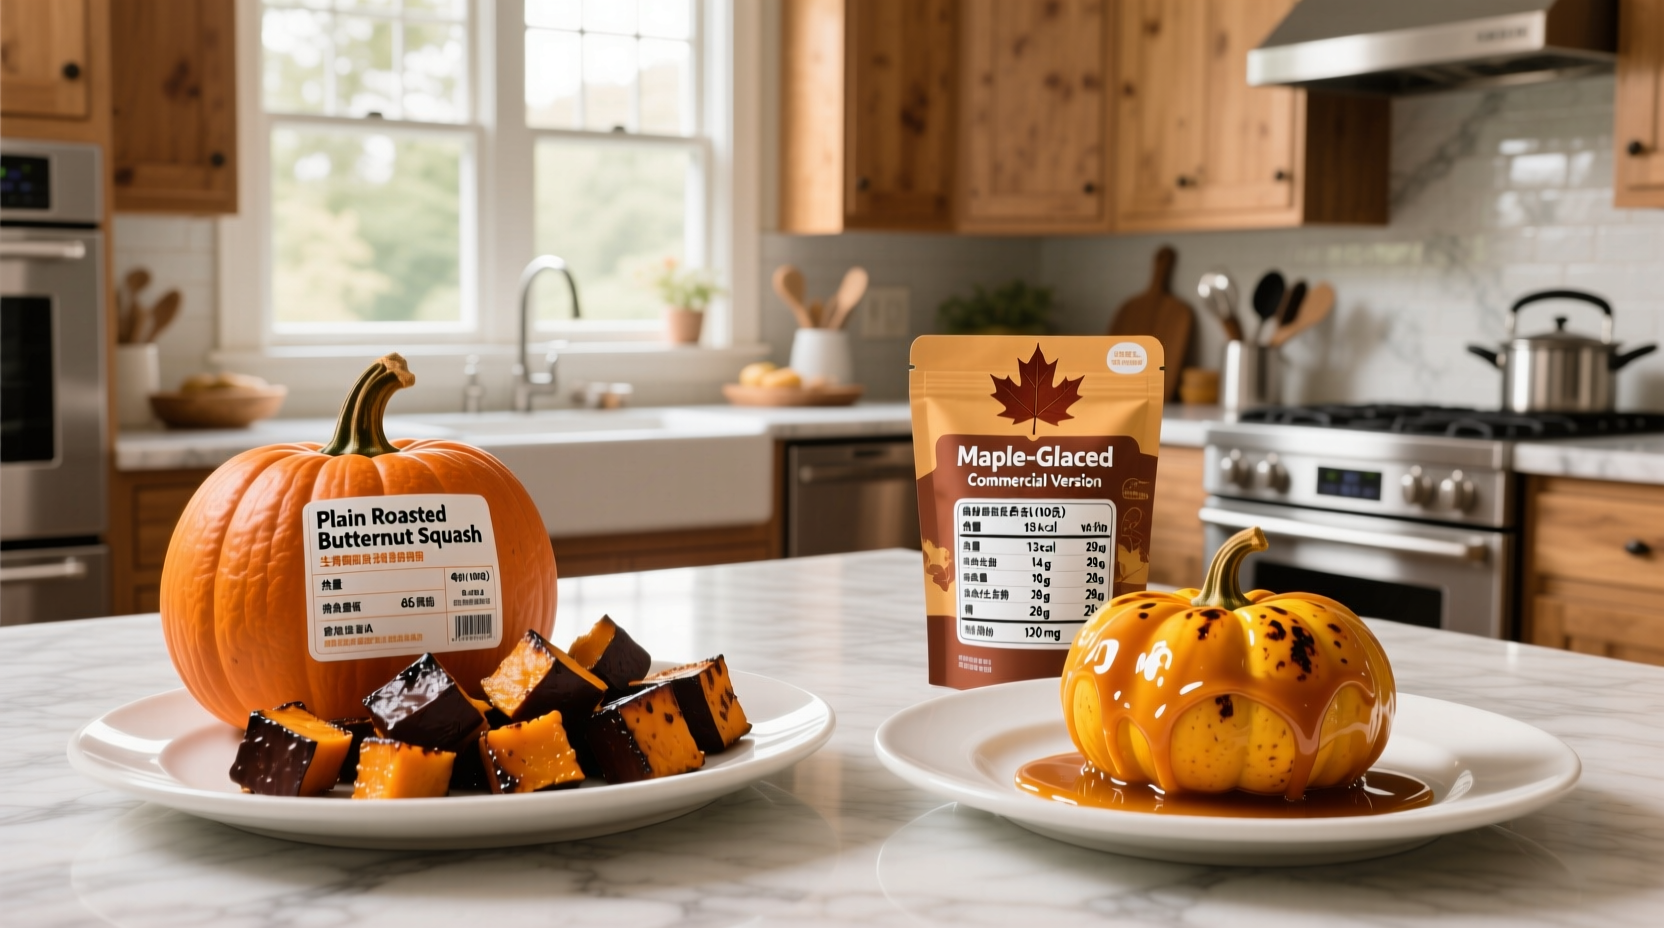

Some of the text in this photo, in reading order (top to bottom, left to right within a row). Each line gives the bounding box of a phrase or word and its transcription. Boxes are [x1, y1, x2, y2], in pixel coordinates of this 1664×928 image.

[957, 445, 1114, 473] Maple-Glaced
[967, 473, 1102, 488] Commercial Version
[316, 504, 447, 529] Plain Roasted
[318, 524, 483, 550] Butternut Squash
